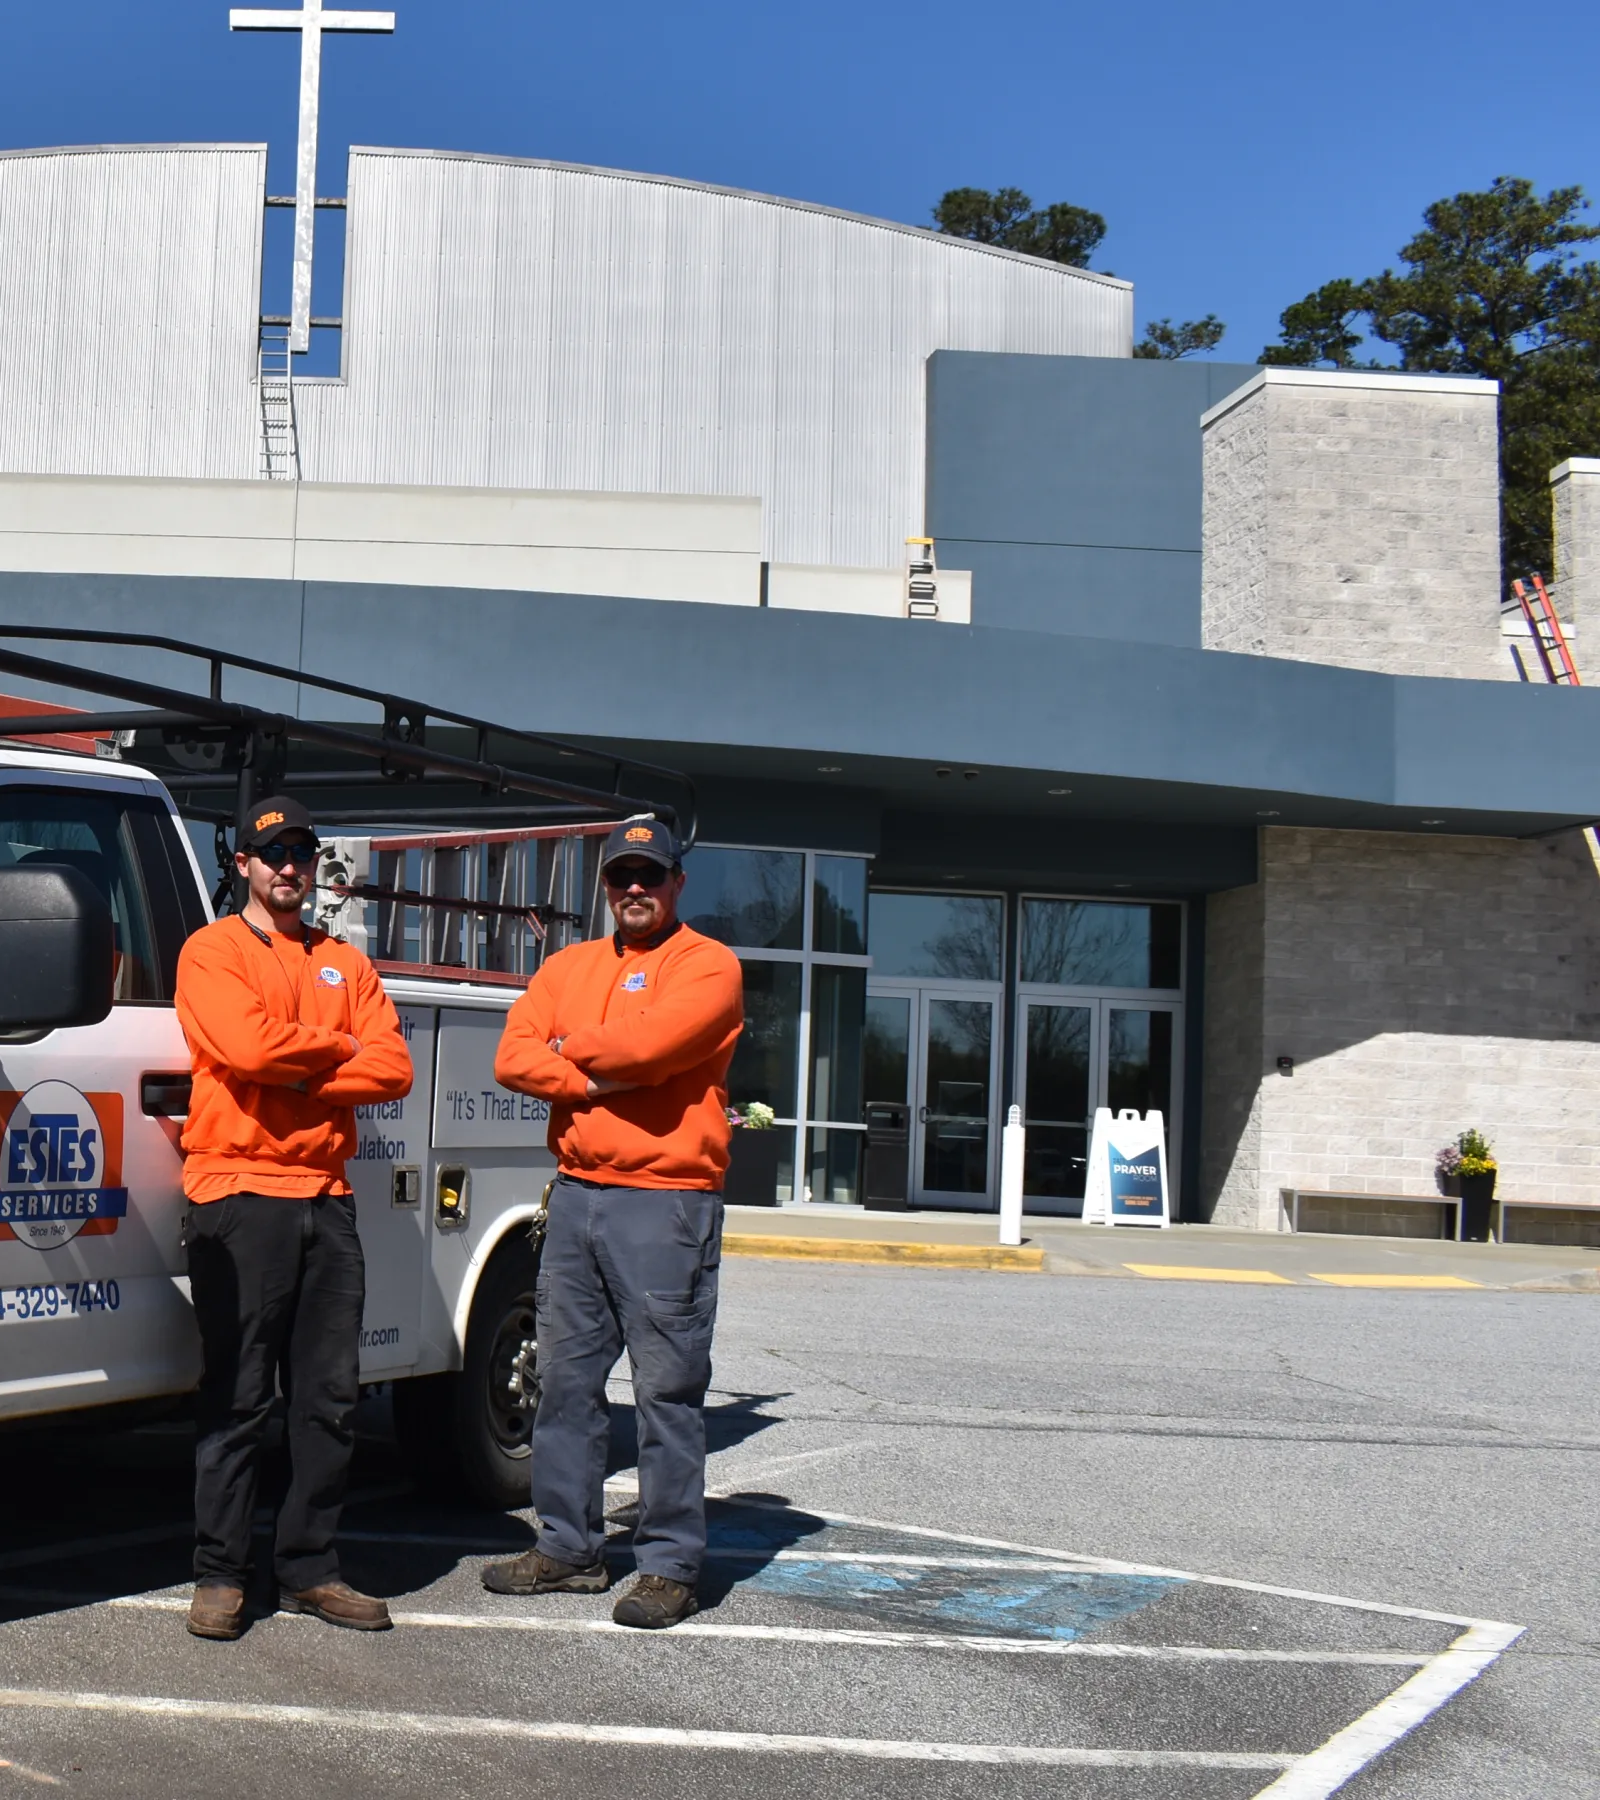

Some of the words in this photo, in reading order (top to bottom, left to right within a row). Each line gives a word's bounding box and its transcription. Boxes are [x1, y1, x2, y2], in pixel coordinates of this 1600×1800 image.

[255, 811, 284, 831] ESTES
[625, 827, 654, 839] ESTES
[354, 1099, 404, 1121] ctrical
[481, 1091, 516, 1121] That
[520, 1094, 553, 1121] Eas
[8, 1114, 96, 1184] ESTES
[353, 1135, 405, 1161] ulation
[1113, 1164, 1157, 1176] PRAYER
[1, 1193, 98, 1217] SERVICES
[29, 1226, 48, 1237] Since
[360, 1327, 399, 1348] ir.com
